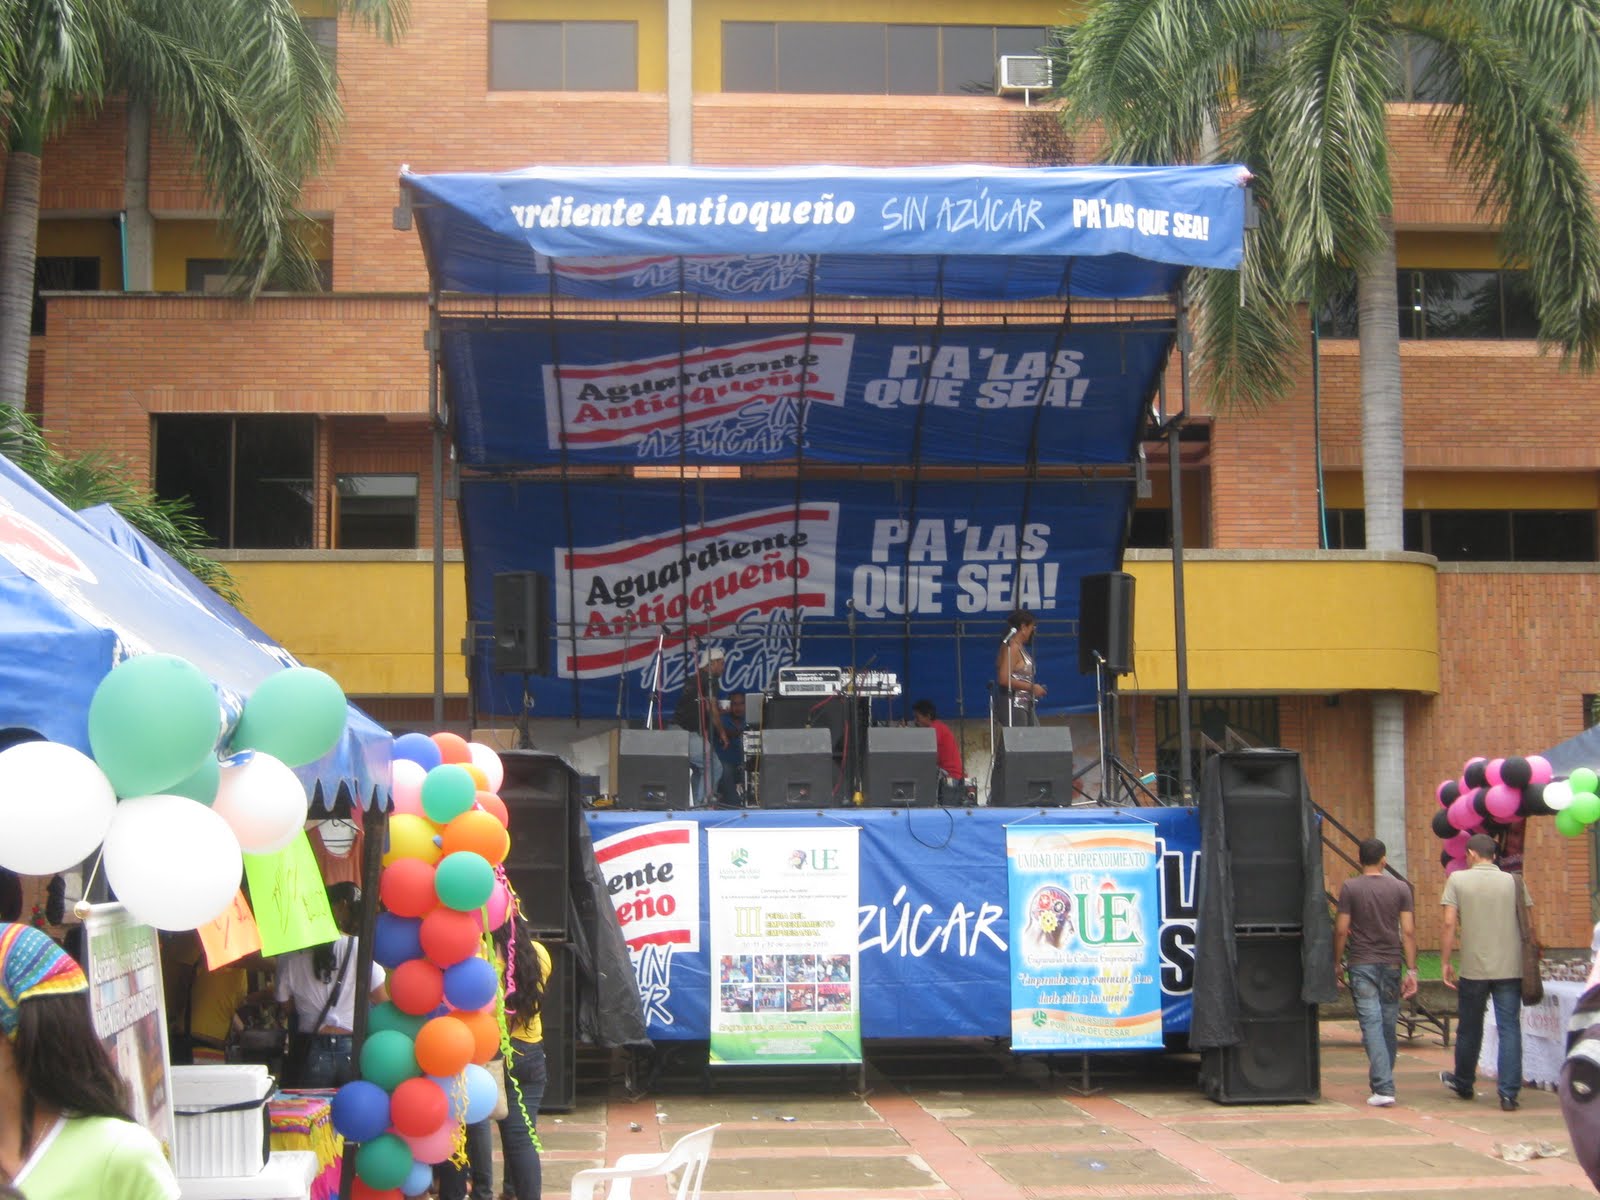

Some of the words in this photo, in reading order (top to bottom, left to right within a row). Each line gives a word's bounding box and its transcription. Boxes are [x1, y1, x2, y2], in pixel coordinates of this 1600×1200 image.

[647, 193, 856, 232] Antioqueño
[882, 196, 929, 231] SIN
[936, 186, 1046, 232] AZÚCAR
[1137, 207, 1169, 237] QUE
[1172, 214, 1209, 241] SEA!
[572, 370, 820, 424] Antioqueño
[576, 352, 820, 404] Aguardiente
[863, 378, 965, 409] QUE
[975, 378, 1090, 409] SEA!
[737, 395, 812, 429] SIN
[582, 551, 811, 639] Antioqueño
[585, 531, 808, 608] Aguardiente
[852, 563, 943, 619] QUE
[956, 562, 1060, 614] SEA!
[735, 605, 804, 652] SIN
[1017, 852, 1051, 869] UNIDAD
[1053, 852, 1066, 868] DE
[1067, 851, 1147, 868] EMPRENDIMIENTO
[1074, 892, 1138, 945] UE
